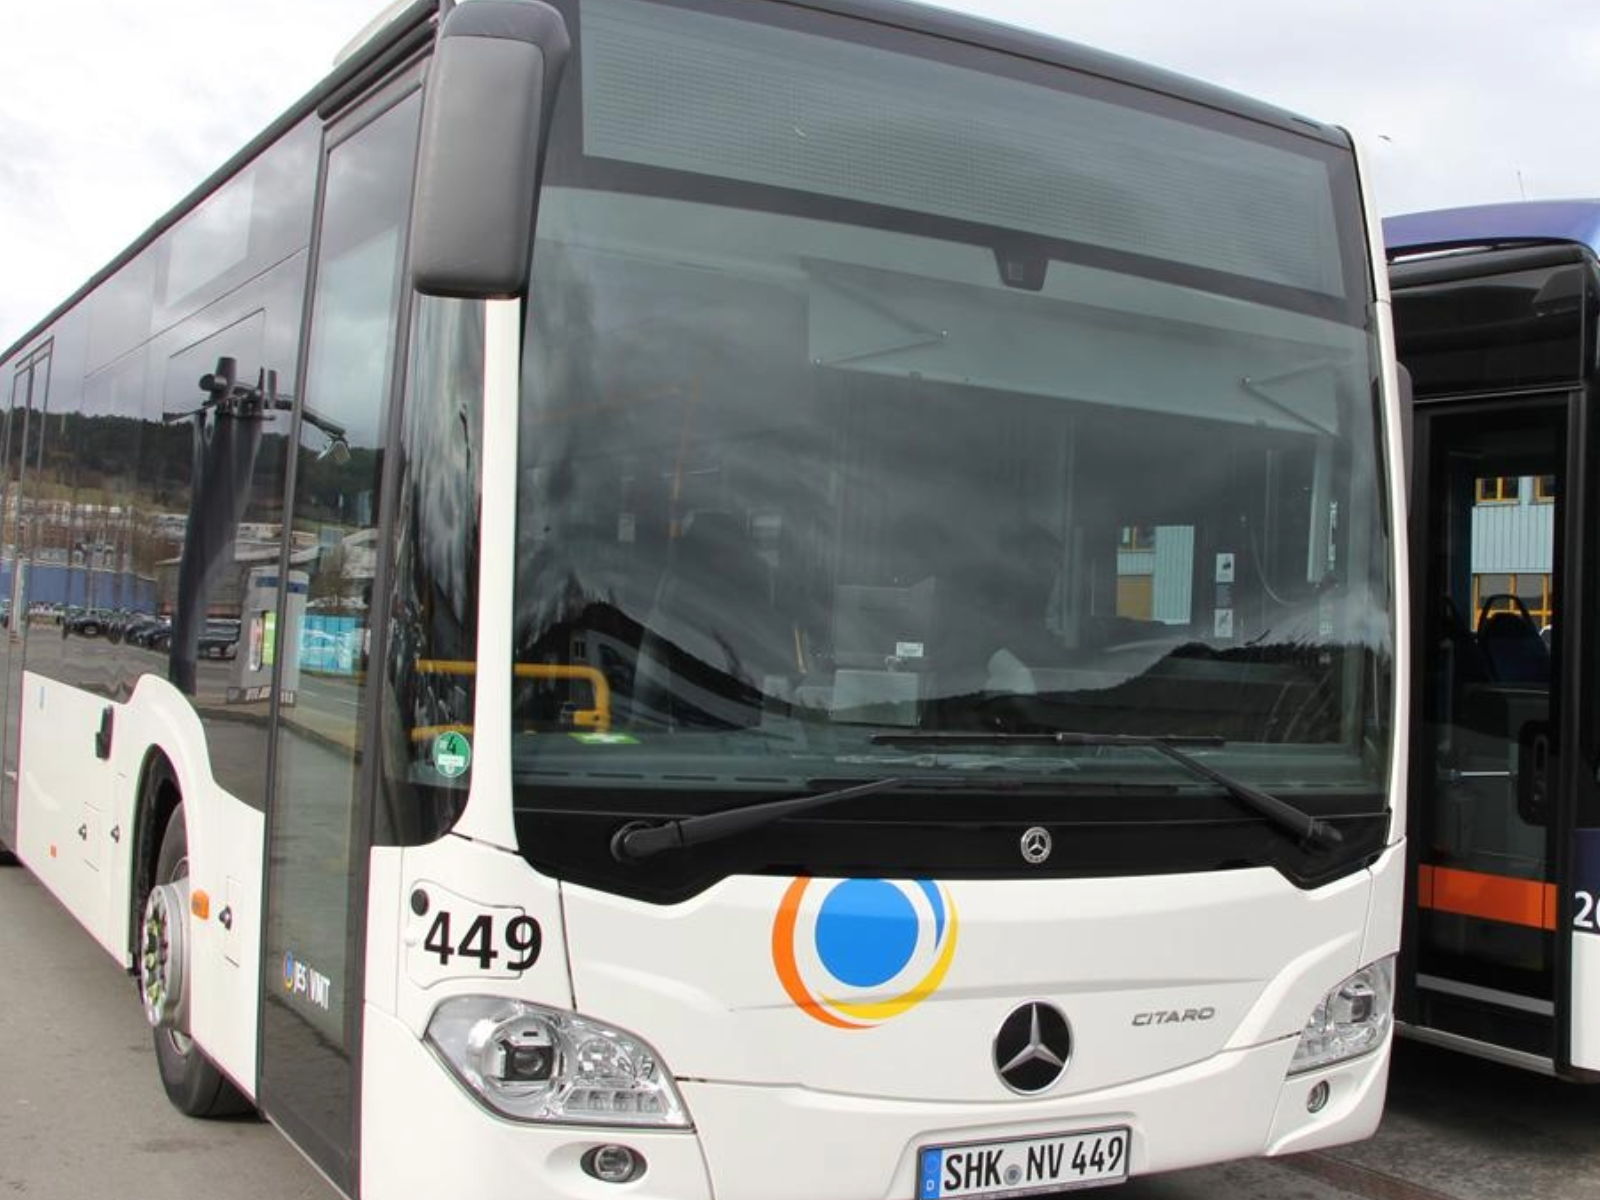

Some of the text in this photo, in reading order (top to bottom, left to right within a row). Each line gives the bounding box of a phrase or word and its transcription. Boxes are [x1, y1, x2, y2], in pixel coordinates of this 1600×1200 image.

[447, 736, 457, 755] 4
[424, 910, 542, 971] 449
[1132, 1007, 1215, 1026] CITARO
[944, 1149, 1003, 1190] SHK
[1026, 1143, 1065, 1181] NV
[1071, 1136, 1124, 1175] 449
